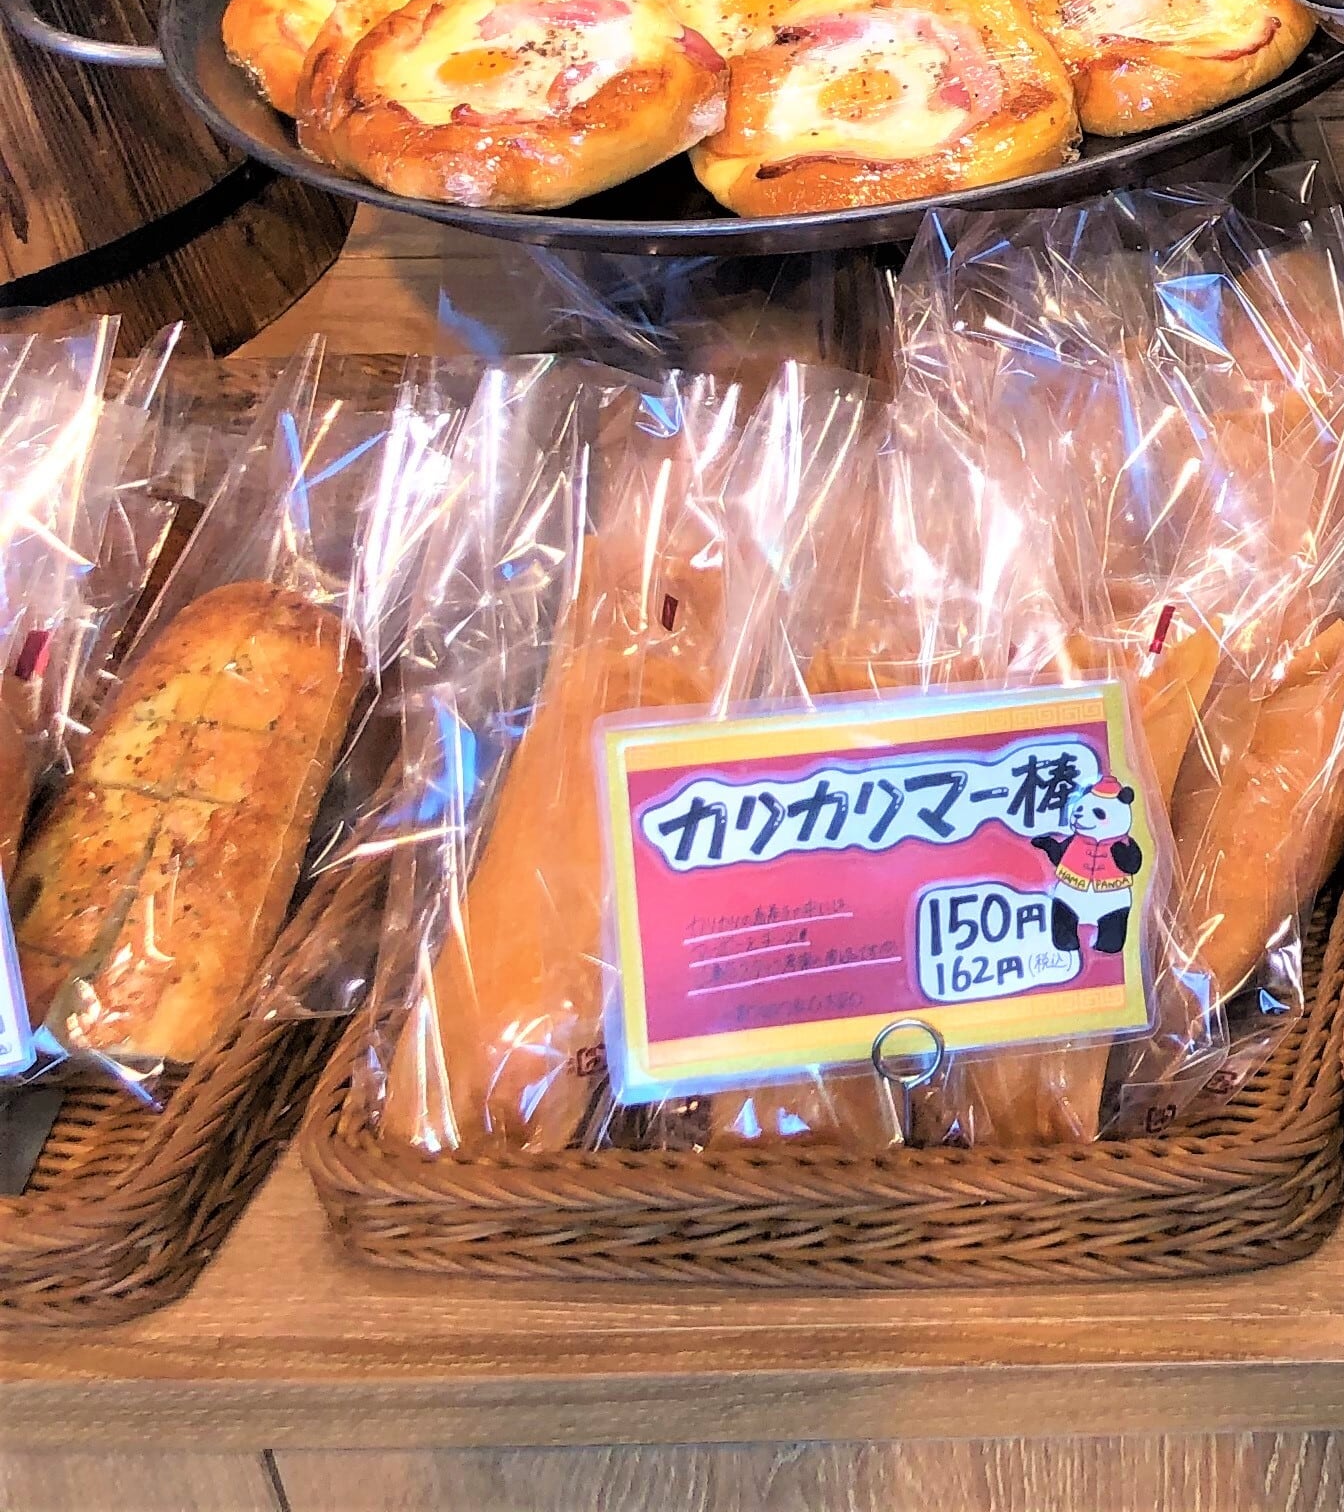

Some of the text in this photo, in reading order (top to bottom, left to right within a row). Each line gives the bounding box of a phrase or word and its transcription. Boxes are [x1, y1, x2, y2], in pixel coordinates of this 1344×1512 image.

[658, 752, 1082, 862] カリカリマー棒
[928, 892, 1047, 957] 150円
[936, 951, 1073, 996] 162円(税込)
